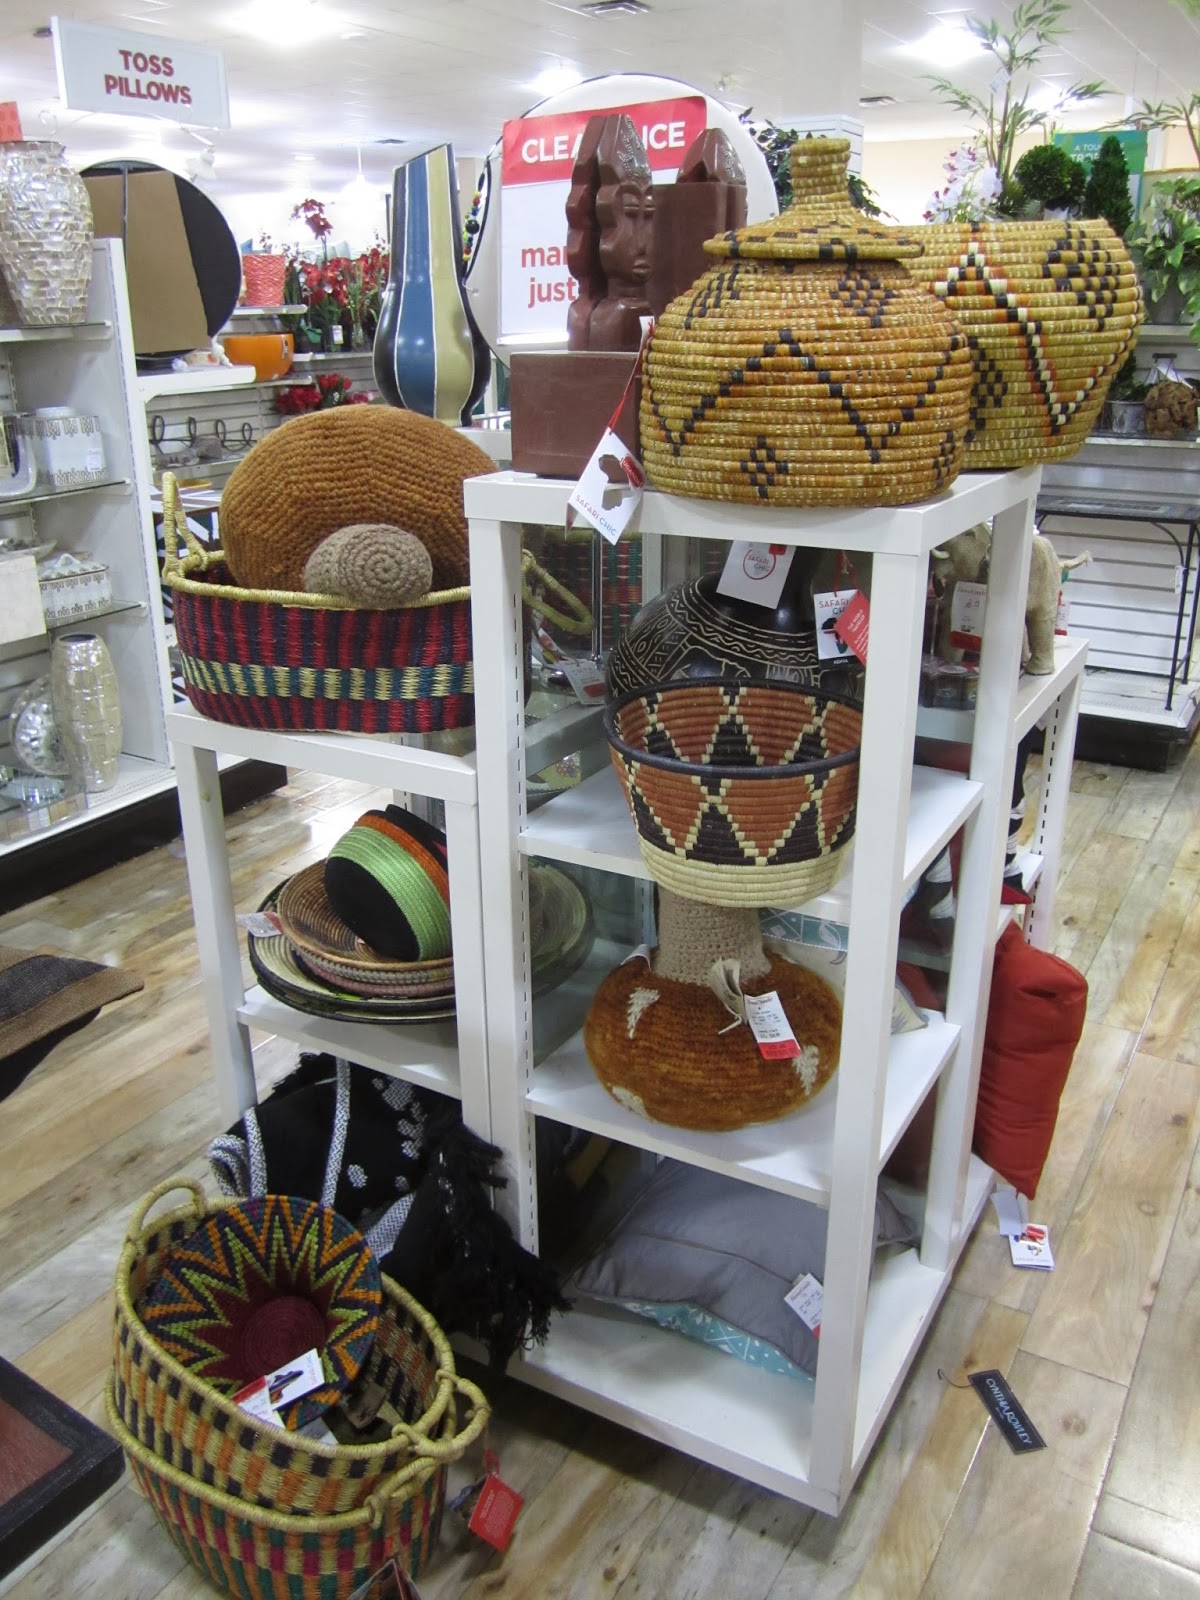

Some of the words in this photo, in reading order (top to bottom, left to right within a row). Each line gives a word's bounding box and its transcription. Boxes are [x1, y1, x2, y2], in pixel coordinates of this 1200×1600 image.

[119, 49, 174, 77] TOSS
[104, 74, 192, 105] PILLOWS
[521, 121, 686, 164] CLECE
[527, 276, 576, 309] just
[575, 494, 600, 519] SAFARI
[599, 517, 618, 536] CHIC
[747, 554, 770, 565] SAFARI
[753, 562, 770, 572] CHIC
[818, 598, 849, 609] SAFARI
[986, 1378, 1010, 1416] CYNTHIA
[1007, 1411, 1033, 1444] ROWLEY
